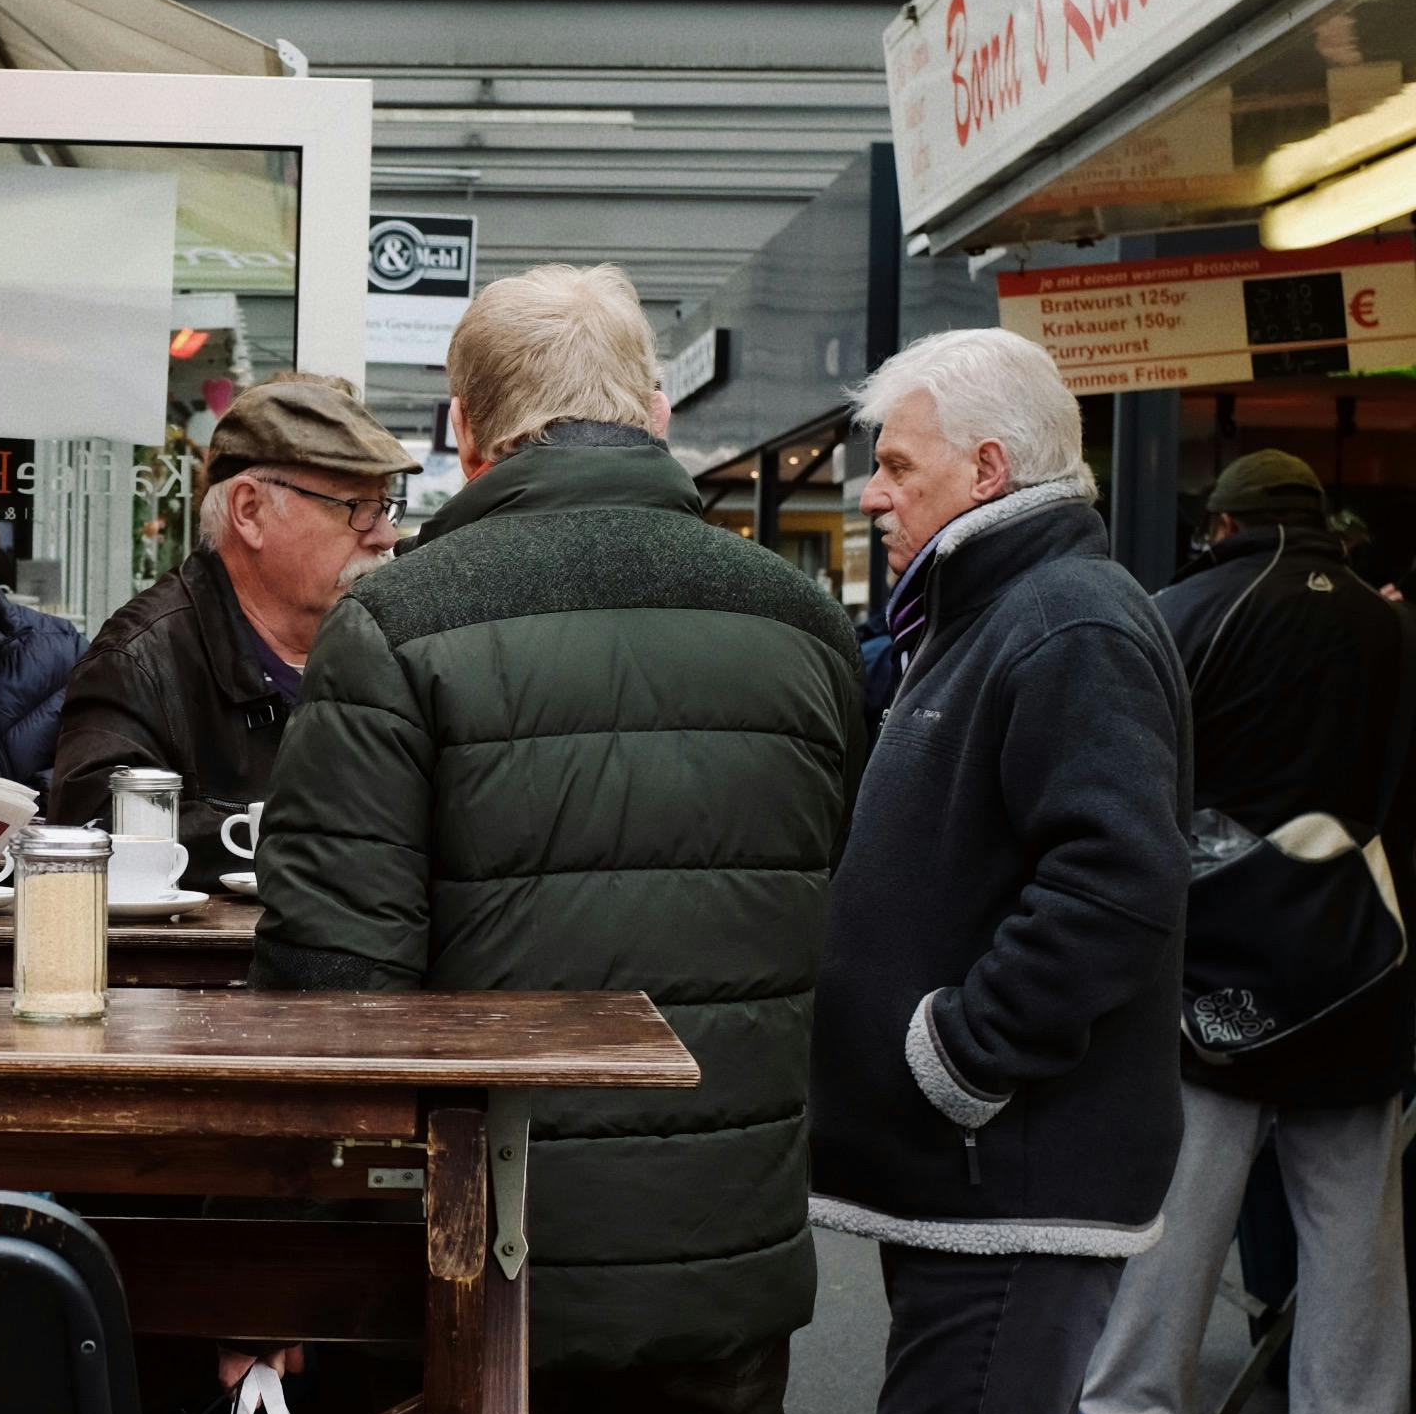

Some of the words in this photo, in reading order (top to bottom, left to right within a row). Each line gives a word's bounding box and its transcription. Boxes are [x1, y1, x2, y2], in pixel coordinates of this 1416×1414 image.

[1057, 274, 1081, 288] mit
[1083, 271, 1128, 286] einem
[1132, 267, 1189, 281] warmen
[1193, 259, 1260, 276] Brötchen
[1040, 294, 1133, 315] Bratwurst
[1042, 317, 1128, 338] Krakauer
[1061, 372, 1129, 389] ommes
[1135, 366, 1188, 384] Frites
